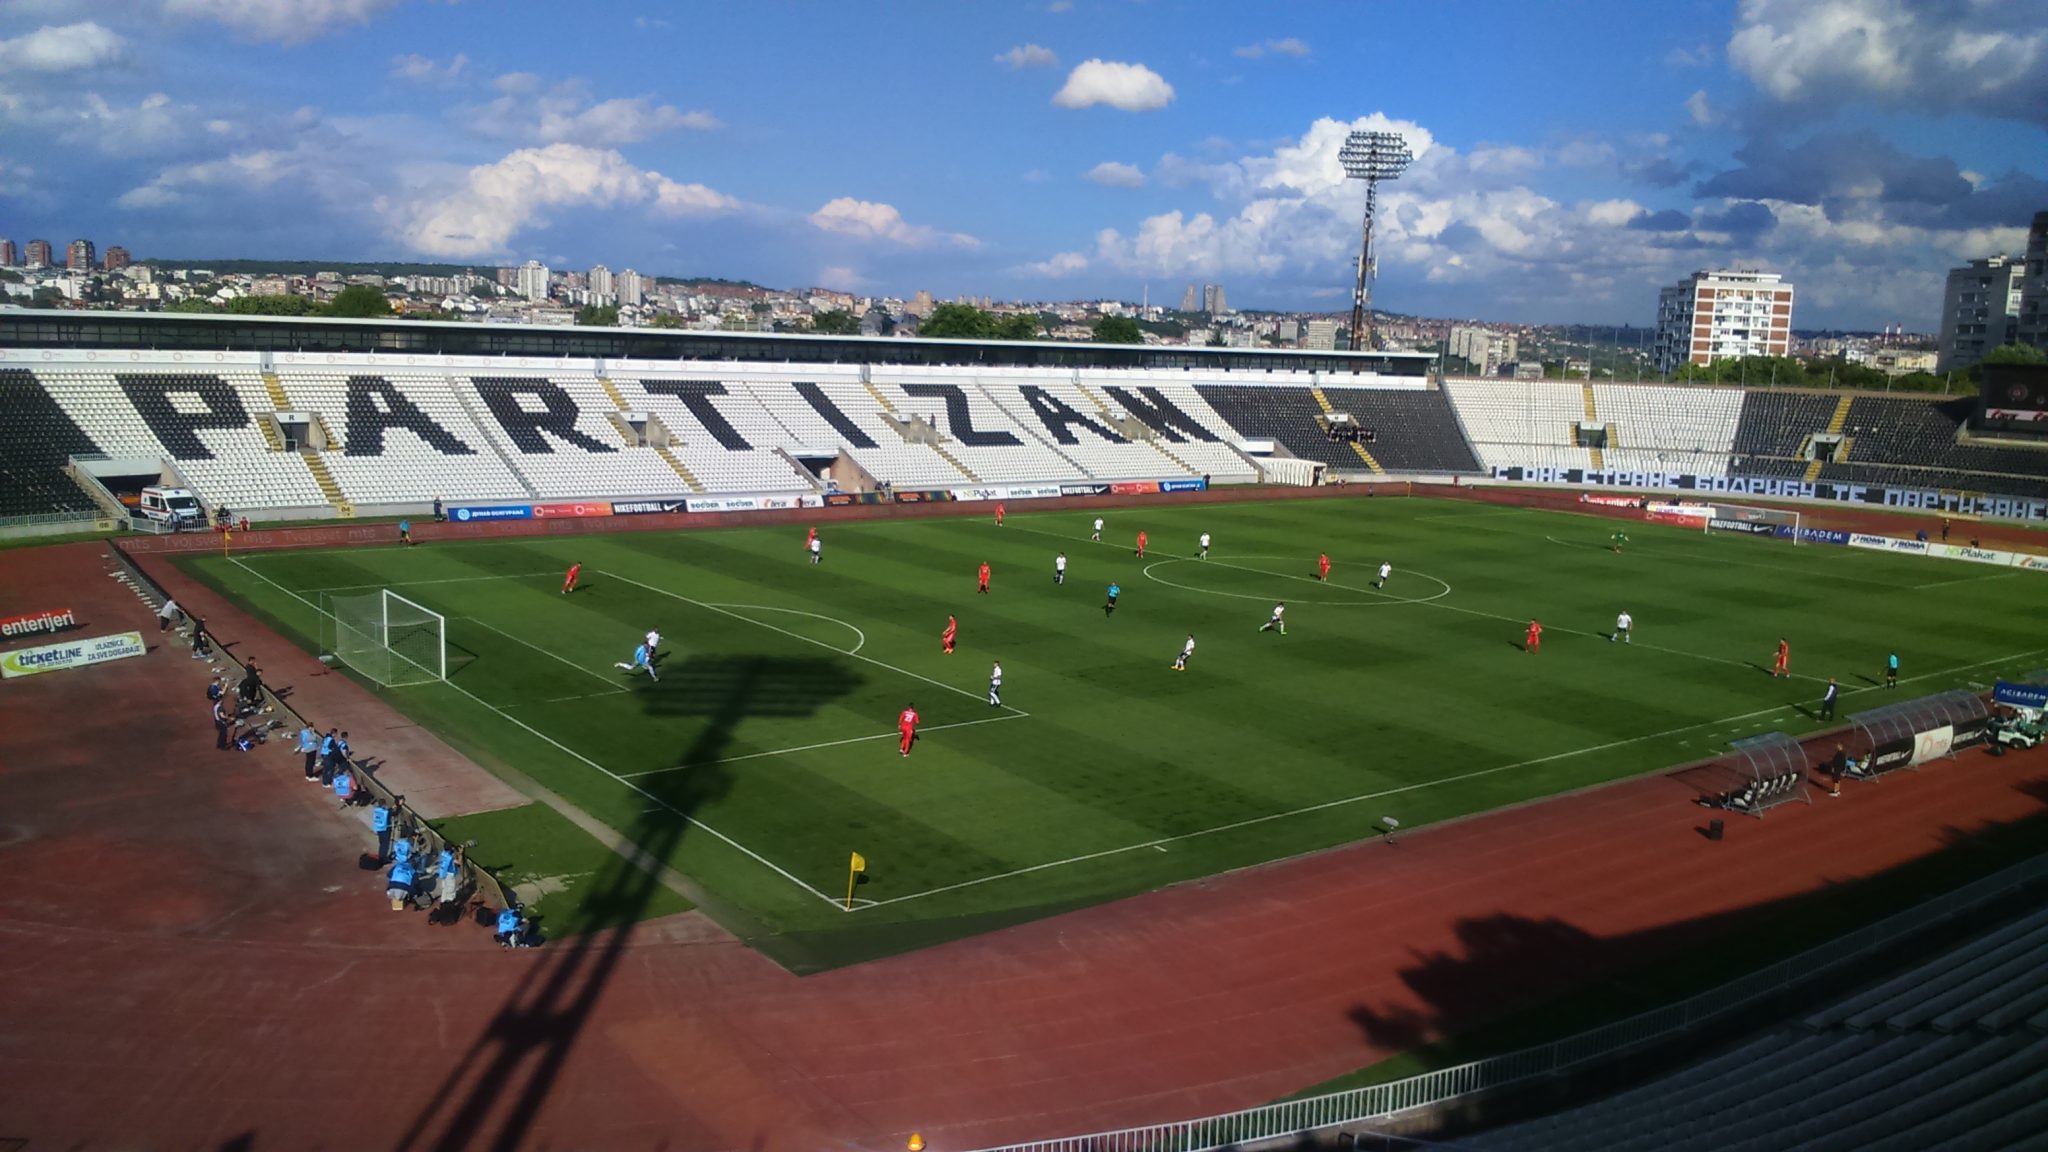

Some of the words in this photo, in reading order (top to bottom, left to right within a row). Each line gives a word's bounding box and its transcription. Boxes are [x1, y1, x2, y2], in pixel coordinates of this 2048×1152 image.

[114, 373, 1225, 460] PARTIZAN
[1522, 468, 1569, 483] ОНЕ
[1582, 469, 1681, 489] СТРАНЕ
[1832, 484, 1867, 503] ТЕ
[614, 502, 662, 513] NIKEFOOTBALL
[119, 539, 150, 550] mts
[349, 528, 376, 540] mts
[1, 609, 76, 636] enterijeri
